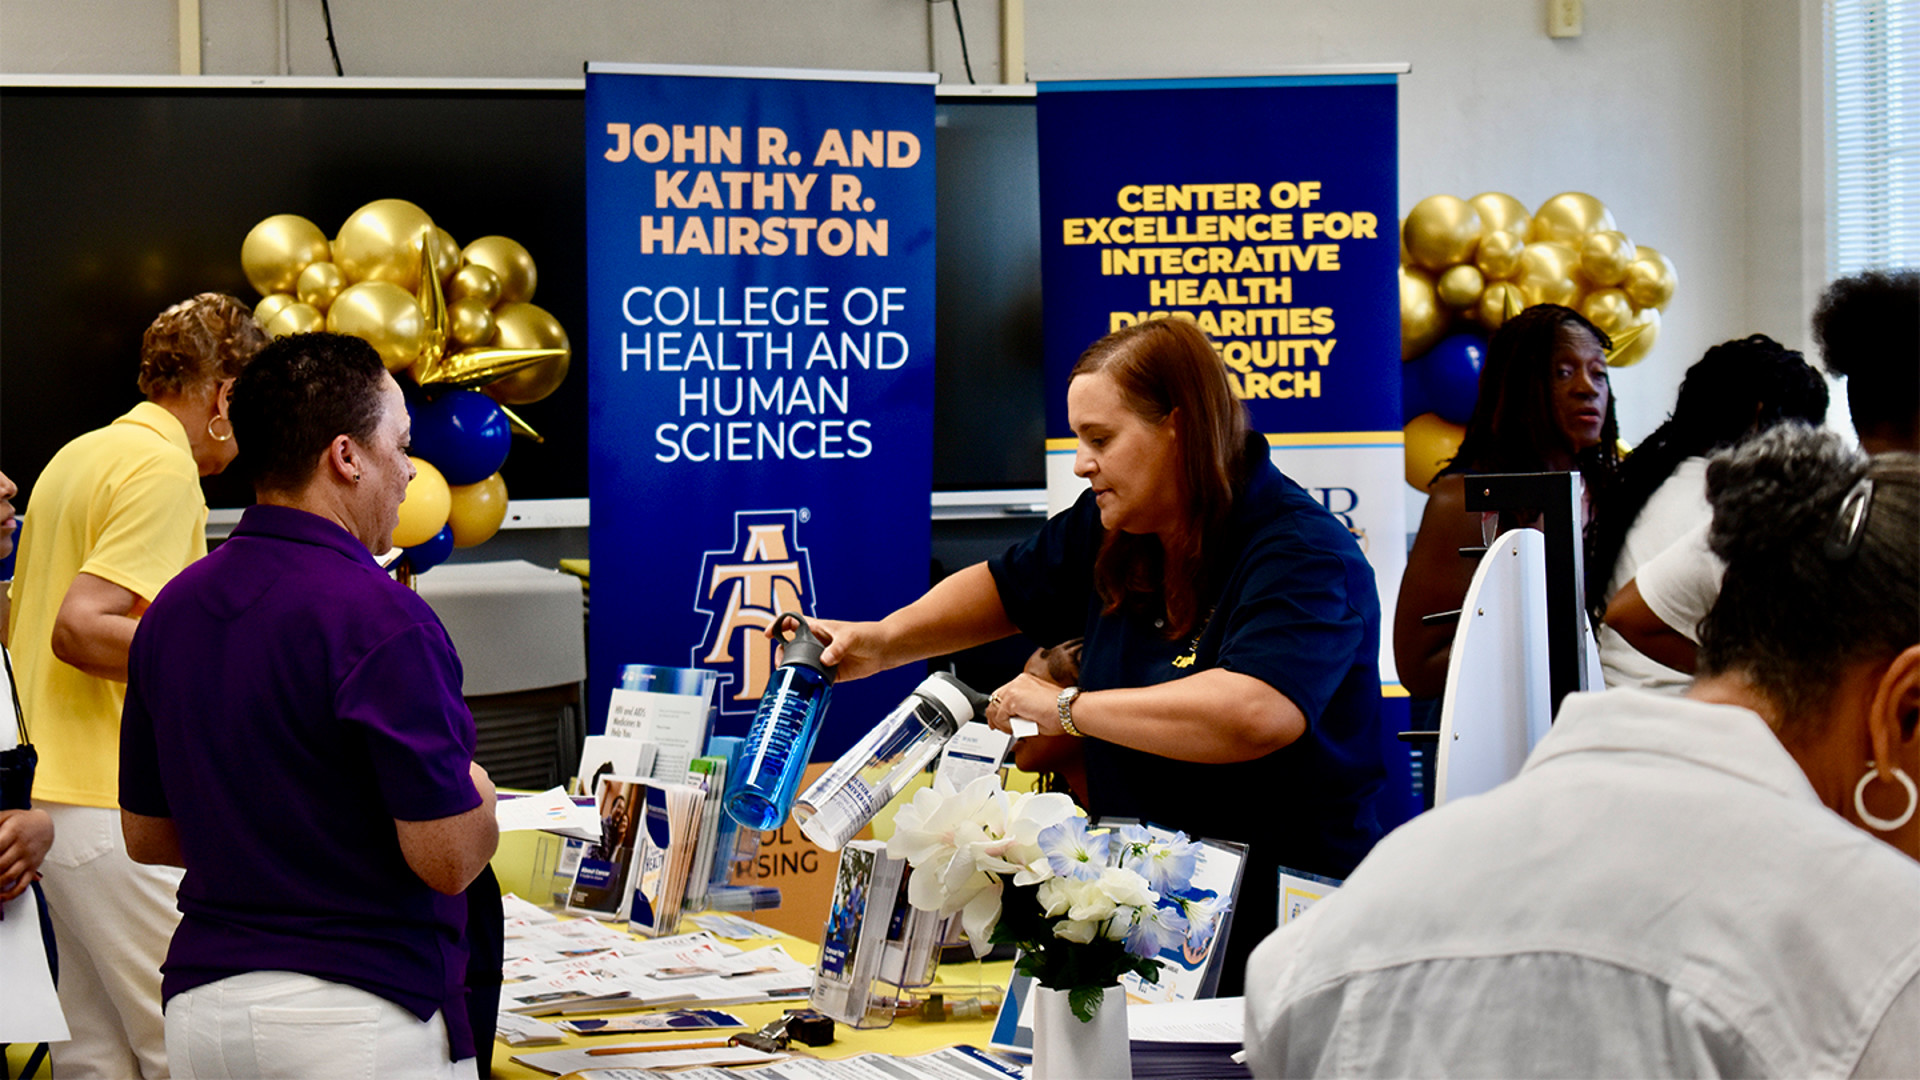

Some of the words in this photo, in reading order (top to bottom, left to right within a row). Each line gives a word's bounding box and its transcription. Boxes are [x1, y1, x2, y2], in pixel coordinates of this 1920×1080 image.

[604, 122, 742, 165] JOHN
[757, 126, 802, 166] R.
[813, 128, 921, 169] AND
[655, 169, 819, 211] KATHY
[830, 173, 876, 213] R.
[1117, 182, 1261, 213] CENTER
[1269, 181, 1322, 210] OF
[640, 215, 889, 257] HAIRSTON
[1063, 213, 1294, 246] EXCELLENCE
[1302, 211, 1378, 241] FOR
[1101, 243, 1341, 277] INTEGRATIVE
[621, 286, 830, 326] COLLEGE
[843, 287, 907, 326] OF
[1149, 276, 1293, 307] HEALTH
[621, 331, 793, 372] HEALTH
[805, 331, 909, 370] AND
[679, 375, 849, 417] HUMAN
[1230, 371, 1321, 400] ARCH
[655, 419, 873, 463] SCIENCES
